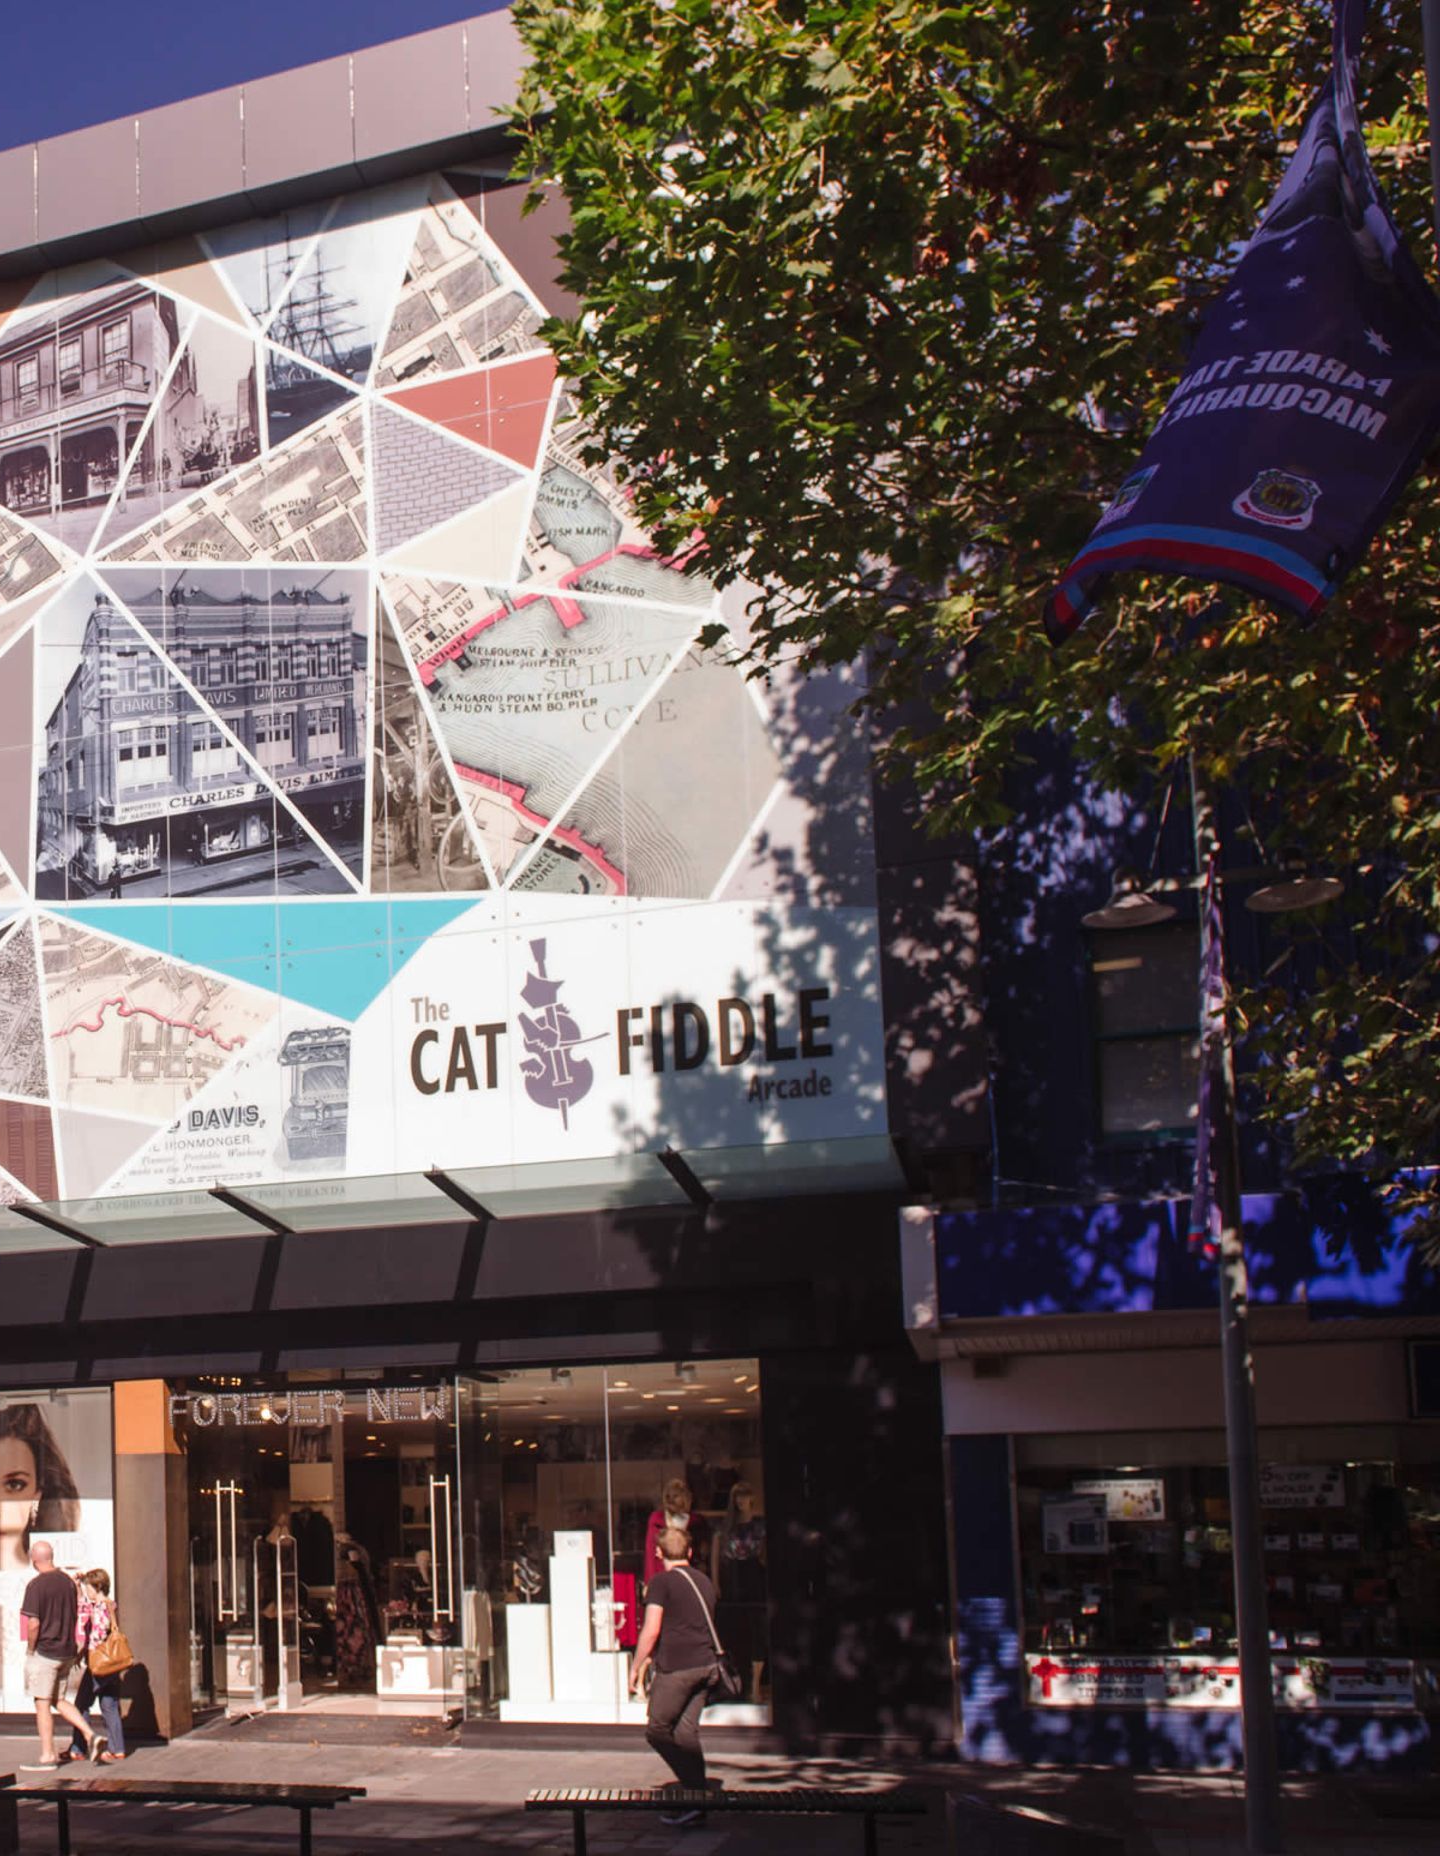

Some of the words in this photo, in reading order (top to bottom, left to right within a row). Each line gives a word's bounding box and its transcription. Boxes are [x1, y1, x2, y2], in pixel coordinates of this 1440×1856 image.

[467, 645, 536, 657] MELBOURNE
[549, 658, 578, 667] PIER
[541, 648, 732, 691] SULLIVANS
[112, 693, 176, 715] CHARLES
[254, 684, 297, 702] LIMITED
[438, 694, 503, 703] KANGAROO
[508, 692, 543, 702] POINT
[546, 688, 585, 701] FERRY
[453, 701, 493, 713] HUON
[498, 702, 542, 713] STEAM
[568, 697, 599, 709] PIER
[581, 697, 679, 734] COVE
[169, 786, 246, 810] CHARLES
[524, 856, 561, 891] STORES
[411, 996, 450, 1024] The
[410, 1021, 508, 1096] CAT
[616, 986, 834, 1076] FIDDLE
[746, 1067, 833, 1102] Arcade
[188, 1104, 266, 1132] DAVIS,
[169, 1389, 345, 1427] FOREVER
[367, 1386, 447, 1424] NEW
